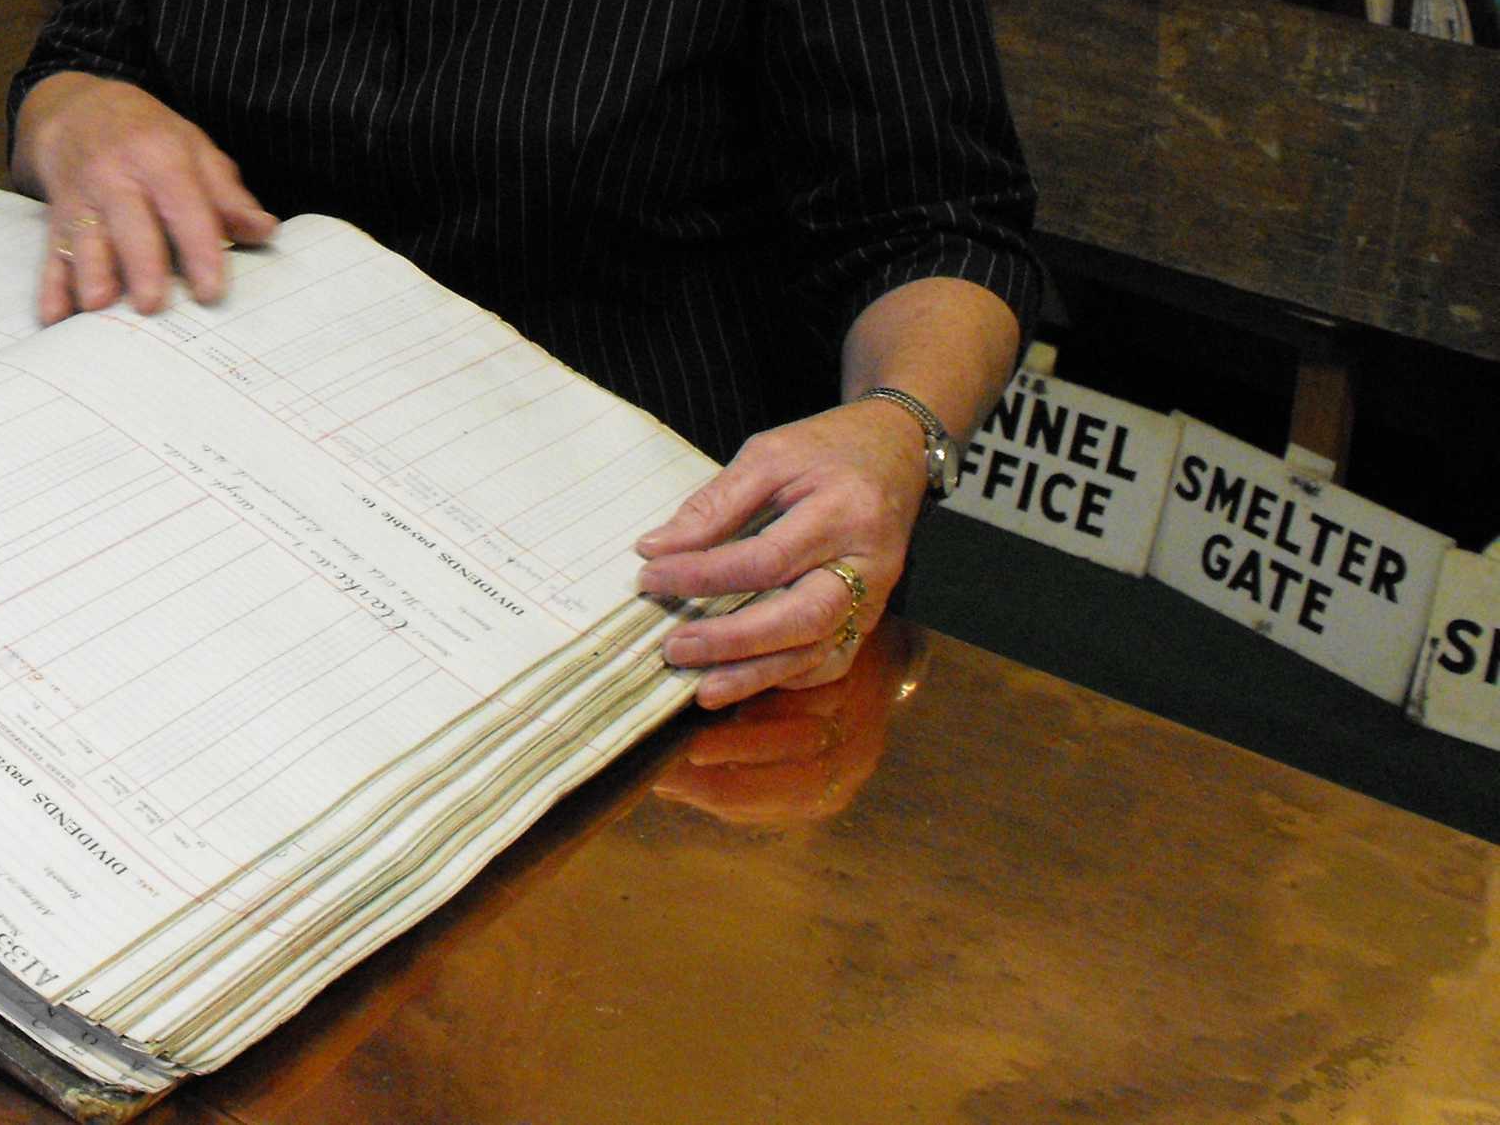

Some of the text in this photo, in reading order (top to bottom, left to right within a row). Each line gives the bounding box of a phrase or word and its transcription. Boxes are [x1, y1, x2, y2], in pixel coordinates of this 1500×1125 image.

[382, 512, 436, 548] payable
[1174, 455, 1408, 604] SMELTER
[439, 553, 523, 615] DIVIDENDS
[1201, 535, 1334, 635] GATE
[34, 794, 126, 874] DIVIDENDS
